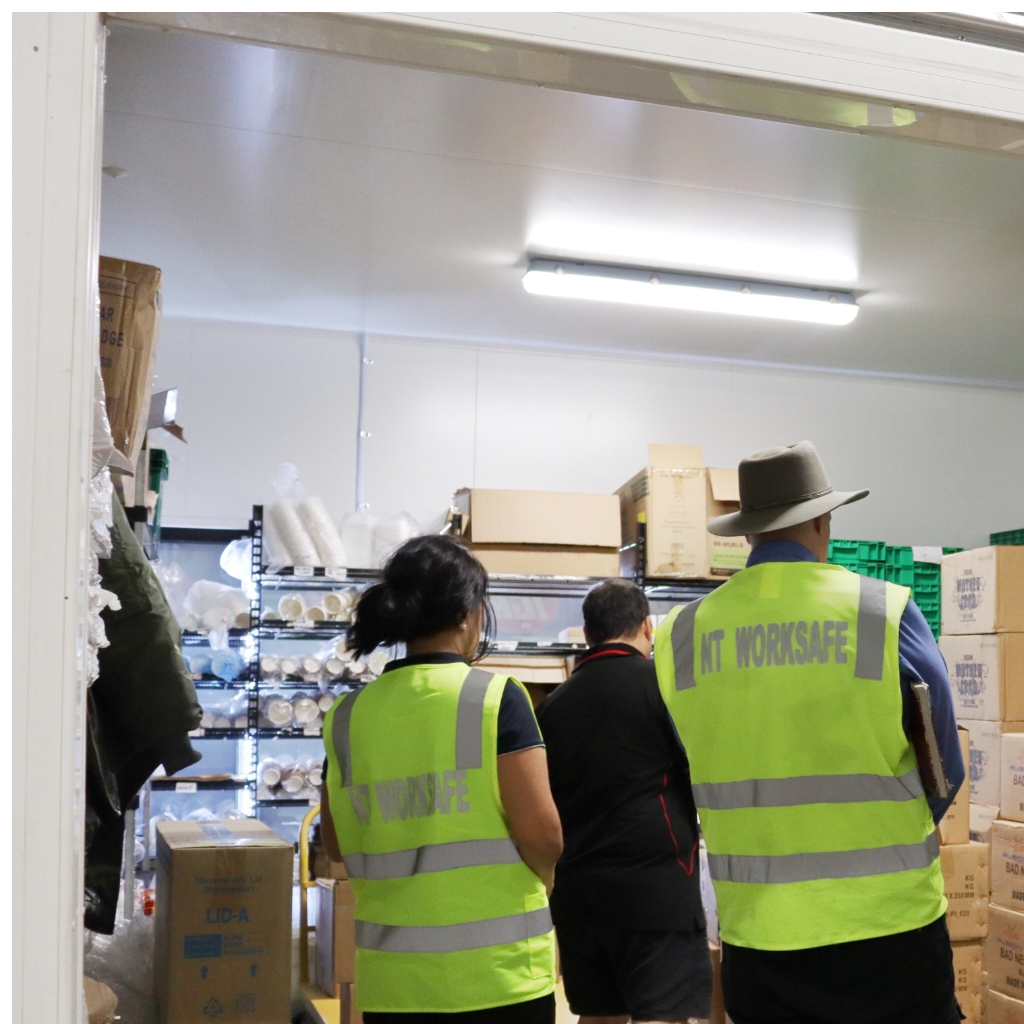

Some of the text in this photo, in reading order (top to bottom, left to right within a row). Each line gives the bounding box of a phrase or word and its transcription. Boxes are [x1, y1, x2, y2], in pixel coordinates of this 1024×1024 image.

[701, 620, 849, 675] NT WORKSAFE
[374, 770, 471, 824] WORKSAFE
[1005, 862, 1019, 875] BAD
[206, 906, 250, 924] LID-A
[1000, 948, 1013, 961] BAD
[1006, 976, 1020, 989] MADE
